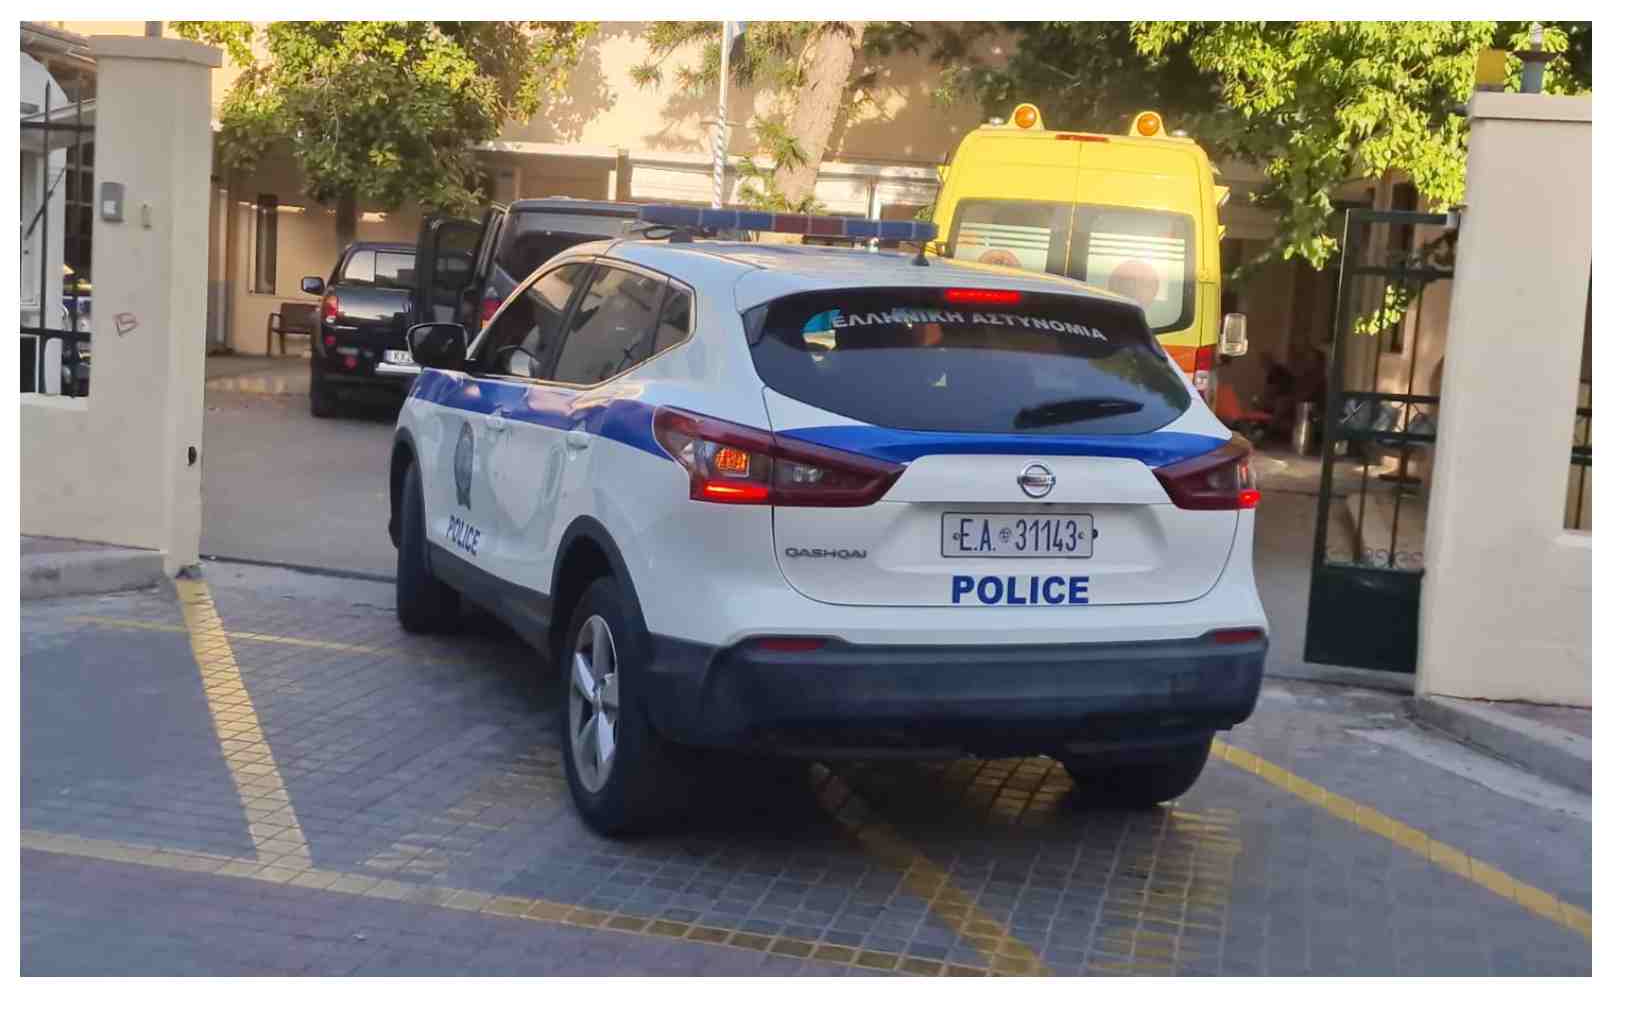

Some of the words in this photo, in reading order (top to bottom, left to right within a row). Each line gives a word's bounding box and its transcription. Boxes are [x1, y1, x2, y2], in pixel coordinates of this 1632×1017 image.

[972, 311, 1109, 342] ΑΣΤΥΝΟΜΙΑ
[447, 515, 481, 556] POLICE
[1016, 519, 1078, 552] 31143
[952, 575, 1090, 605] POLICE
